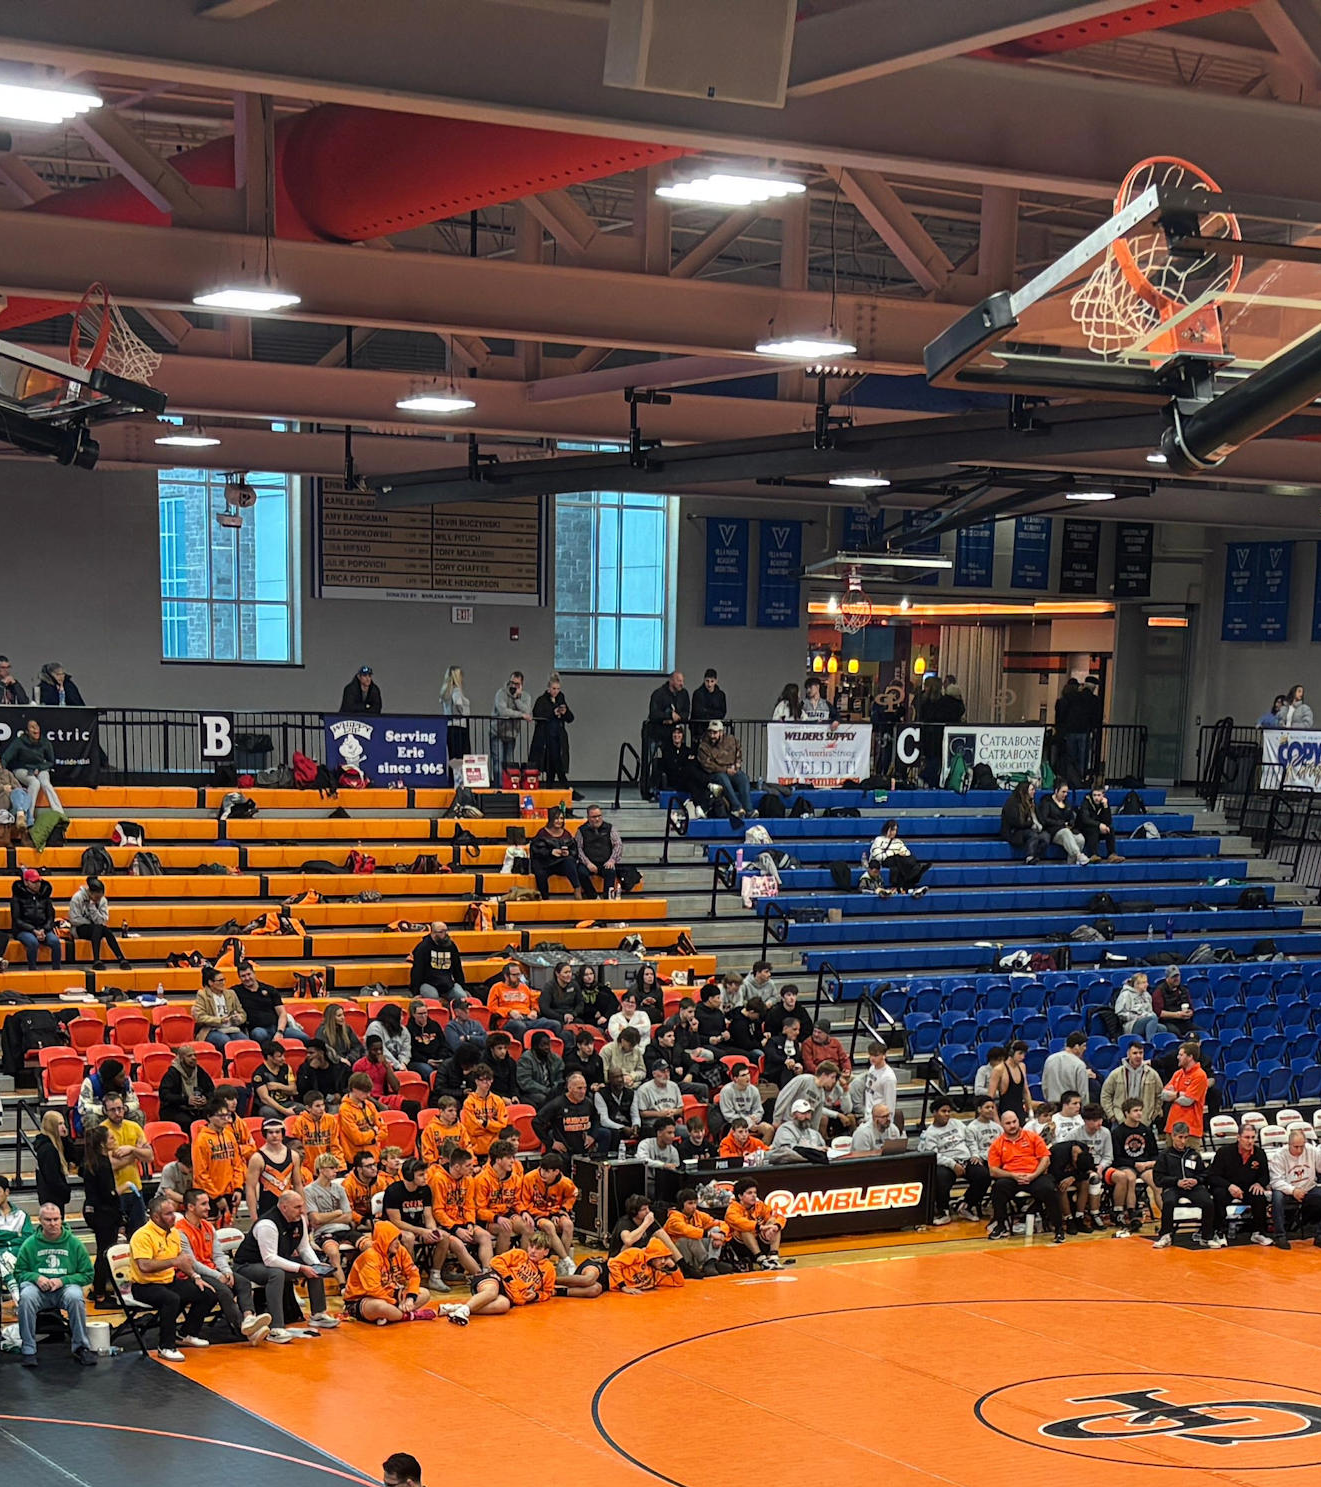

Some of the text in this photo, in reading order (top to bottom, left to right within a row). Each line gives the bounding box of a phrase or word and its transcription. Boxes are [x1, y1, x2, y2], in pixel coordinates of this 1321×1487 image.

[434, 548, 455, 557] TONY
[434, 578, 500, 588] MIKE HENDERSON
[16, 728, 91, 741] ectric
[202, 715, 233, 757] B
[385, 729, 437, 744] Serving
[784, 731, 857, 741] WELDERS SUPPLY
[896, 727, 921, 765] C
[397, 748, 425, 759] Erie
[377, 763, 445, 775] since 1965
[783, 760, 832, 775] WELD
[764, 1181, 923, 1218] RAMBLERS
